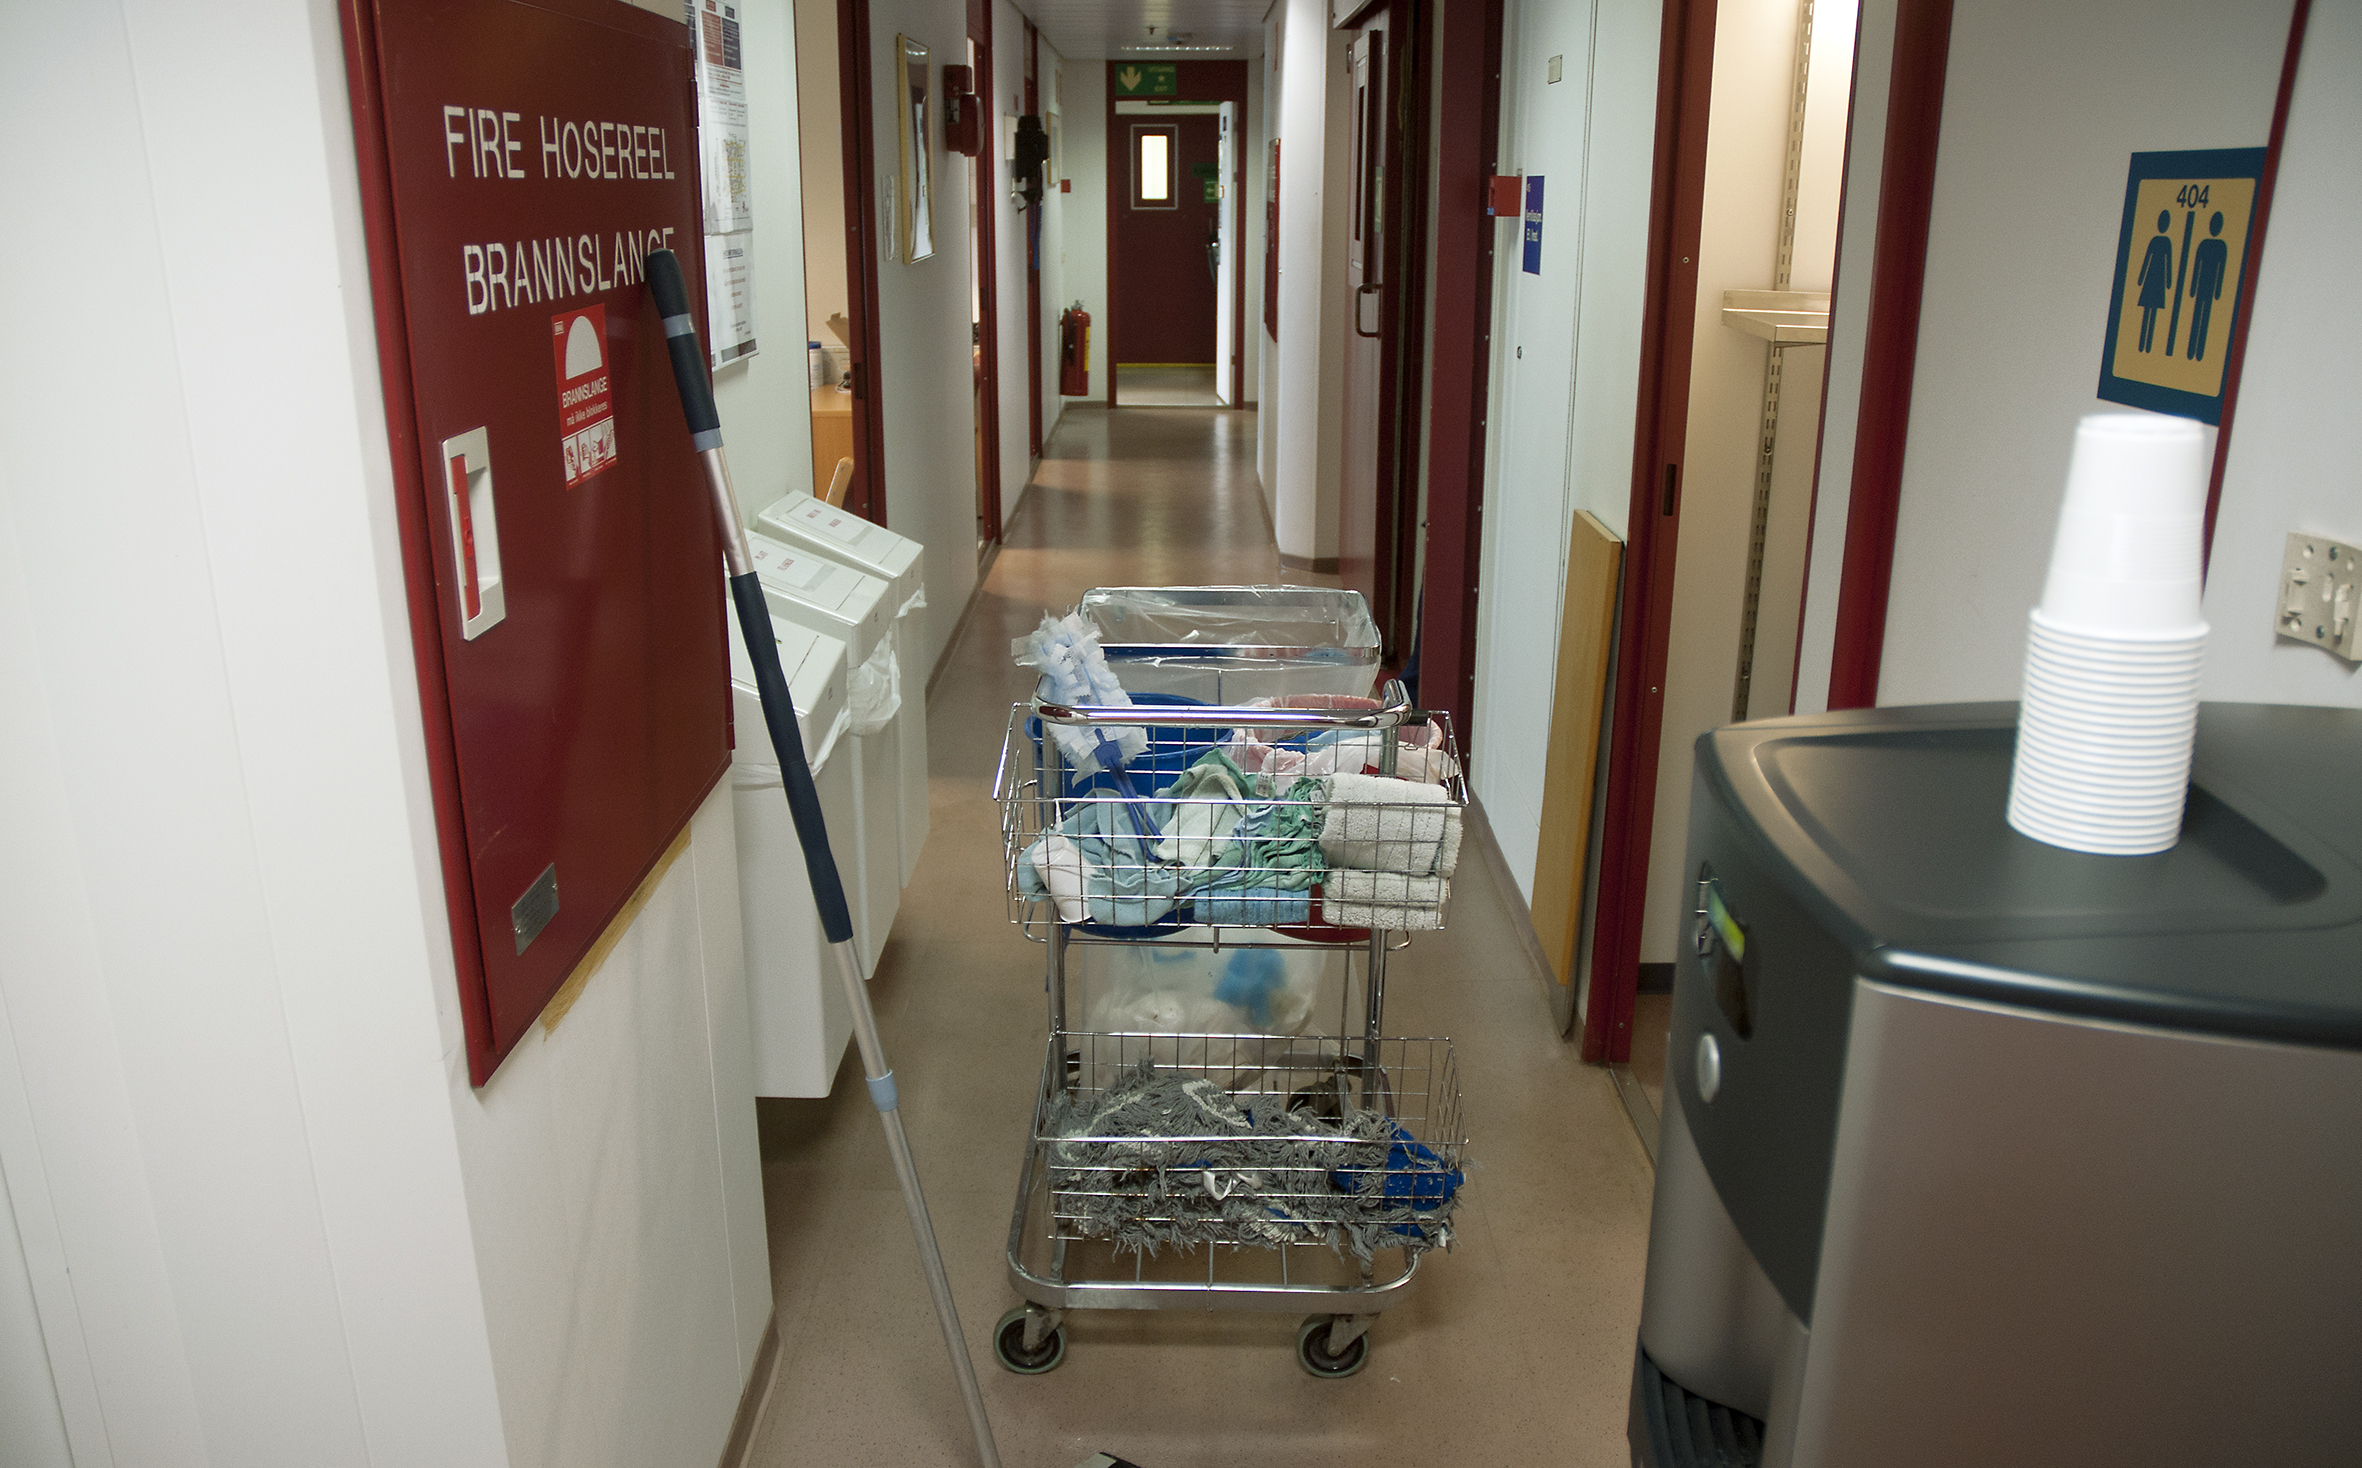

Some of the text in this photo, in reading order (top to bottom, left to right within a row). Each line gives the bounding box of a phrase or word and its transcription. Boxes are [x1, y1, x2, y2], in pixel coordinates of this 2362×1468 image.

[443, 105, 525, 178] FIRE
[540, 116, 675, 180] HOSEREEL
[2176, 185, 2210, 208] 404
[562, 377, 608, 408] BRANNSLANGE
[575, 408, 586, 422] ikke
[586, 401, 608, 419] blokkeres
